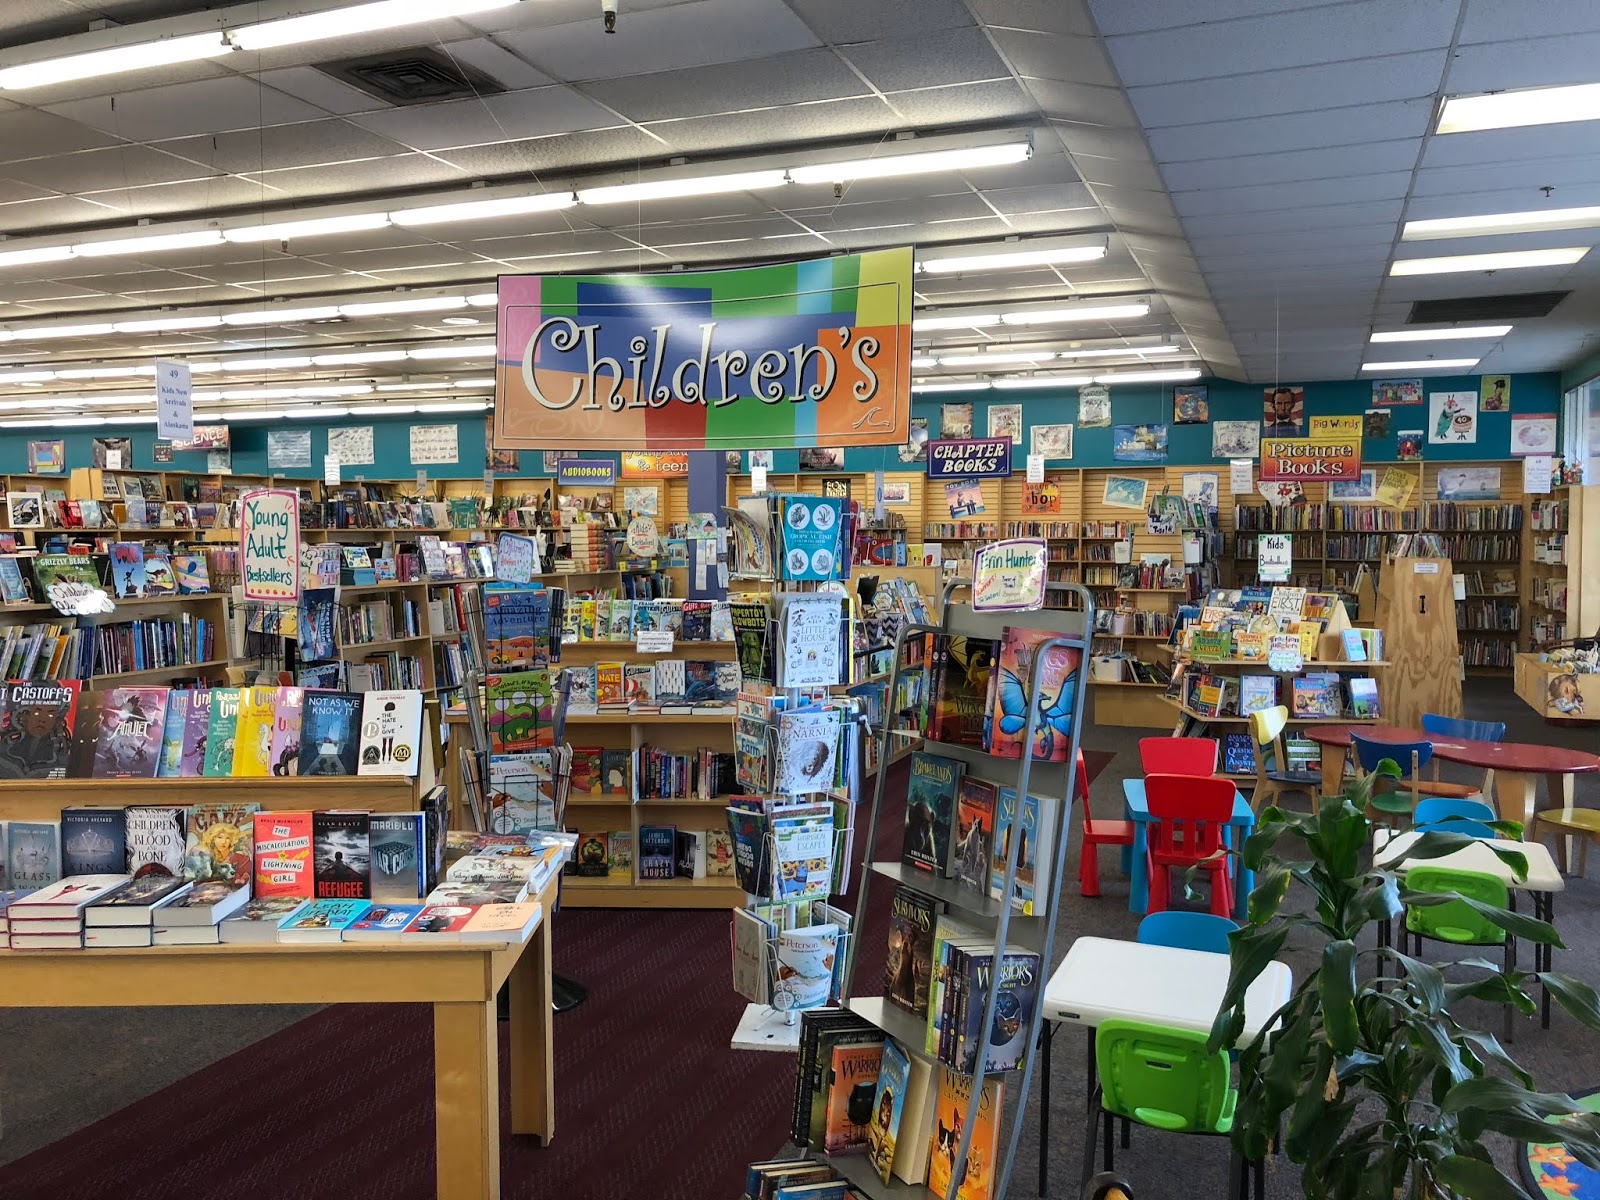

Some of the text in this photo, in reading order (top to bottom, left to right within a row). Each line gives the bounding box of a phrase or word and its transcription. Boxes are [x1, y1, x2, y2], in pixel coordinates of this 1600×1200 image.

[521, 316, 881, 413] Children's
[169, 369, 179, 378] 49
[161, 385, 188, 396] Kids New
[163, 398, 187, 407] Arrivals
[172, 410, 179, 418] &
[163, 421, 189, 430] Alaskana
[1313, 419, 1360, 429] Big Words
[933, 443, 1005, 459] CHAPTER
[1268, 442, 1353, 458] Picture
[637, 460, 650, 472] &
[941, 458, 998, 473] BOOKS
[1278, 458, 1344, 475] Books
[562, 467, 612, 477] AUDIOBOOKS
[246, 500, 290, 540] Young
[245, 535, 286, 560] Adult
[1266, 537, 1285, 550] Kids
[40, 556, 91, 567] GRIZZLY BEARS
[980, 552, 1003, 570] Erin
[245, 564, 293, 586] Bestsellers
[1271, 597, 1301, 612] FIRST
[495, 605, 542, 616] Amazing
[730, 607, 764, 616] PAPERTOY
[490, 615, 546, 626] Adventure
[732, 617, 767, 627] GLOWBOTS
[800, 625, 828, 634] LITTLE
[800, 634, 827, 642] HOUSE
[598, 673, 621, 682] NATE
[12, 686, 73, 703] CASTOFFS
[308, 697, 360, 708] NOT AS WE
[956, 695, 986, 714] WING
[312, 707, 355, 716] KNOW IT
[106, 720, 154, 741] AMULET
[792, 726, 833, 739] NARNIA
[741, 738, 760, 756] Farm
[496, 766, 529, 776] Peterson
[913, 757, 953, 785] BRAVELANDS
[127, 820, 176, 830] CHILDREN
[370, 820, 414, 831] MARIE LU
[274, 827, 288, 835] THE
[134, 834, 171, 846] BLOOD
[256, 839, 309, 851] MISCALCULATIONS
[138, 850, 167, 862] BONE
[263, 860, 303, 869] LIGHTNING
[643, 858, 670, 868] CRAZY
[14, 871, 51, 881] GLASS
[643, 868, 670, 877] HOUSE
[273, 875, 294, 883] GIRL
[318, 881, 364, 898] REFUGEE
[891, 897, 931, 932] SURVIVORS
[786, 938, 819, 949] Peterson
[977, 964, 1033, 989] WRIORS
